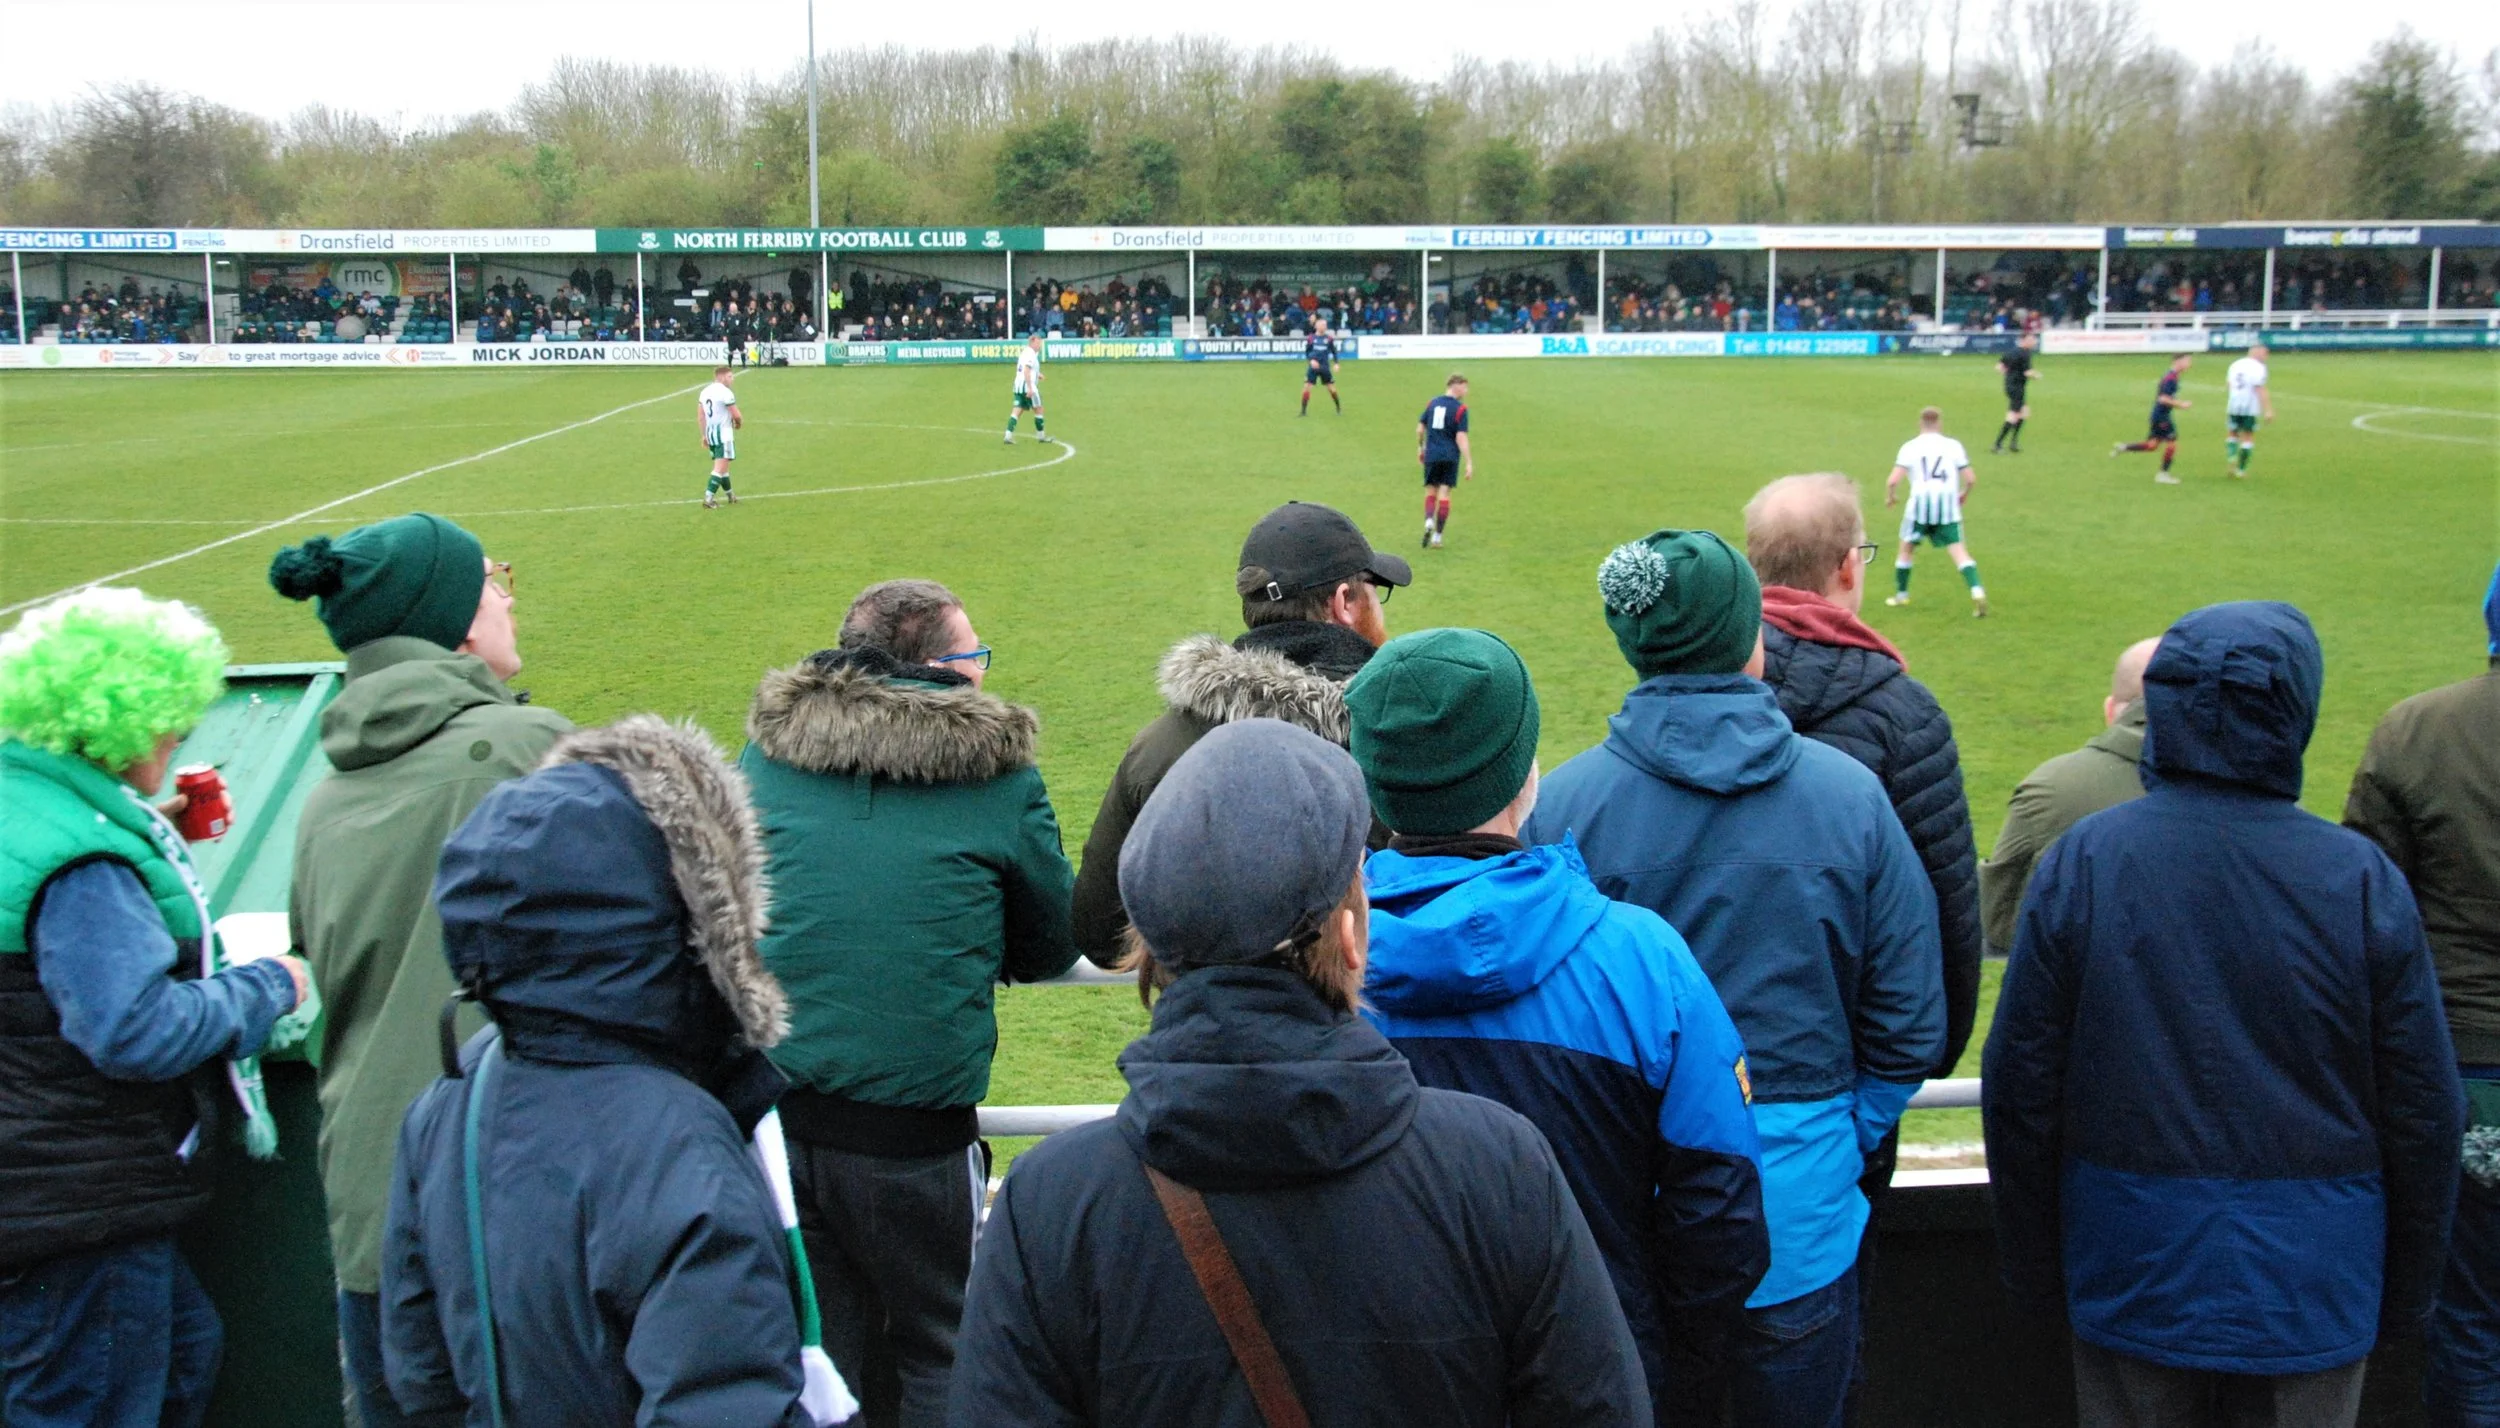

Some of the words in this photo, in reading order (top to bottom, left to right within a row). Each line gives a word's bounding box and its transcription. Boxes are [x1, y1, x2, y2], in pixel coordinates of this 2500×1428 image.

[90, 233, 172, 248] LIMITED
[300, 233, 394, 250] Dransfield
[403, 236, 489, 248] PROPERTIES
[493, 236, 551, 247] LIMITED
[674, 233, 738, 248] NORTH
[743, 232, 814, 248] FERRIBY
[820, 231, 914, 247] FOOTBALL
[919, 231, 967, 246] CLUB
[1113, 230, 1203, 247] Dransfield
[1212, 232, 1295, 244] PROPERTIES
[1300, 232, 1355, 244] LIMITED
[1458, 230, 1540, 246] FERRIBY
[1543, 230, 1625, 246] FENCING
[1630, 230, 1707, 246] LIMITED
[344, 269, 385, 283] rmc
[472, 348, 522, 361] MICK
[528, 347, 606, 361] JORDAN
[611, 346, 719, 361] CONSTRUCTION
[793, 346, 817, 361] LTD
[897, 347, 922, 359] METAL
[924, 346, 966, 358] RECYCLERS
[1048, 342, 1175, 360] www.adraper.co.uk
[1199, 340, 1231, 354] YOUTH
[1234, 340, 1270, 353] PLAYER
[1596, 339, 1717, 353] SCAFFOLDING
[178, 351, 198, 363] Say
[228, 351, 241, 361] to
[245, 351, 276, 364] great
[280, 351, 338, 364] mortgage
[343, 350, 381, 361] advice
[706, 398, 713, 418] 3
[1920, 455, 1948, 483] 14
